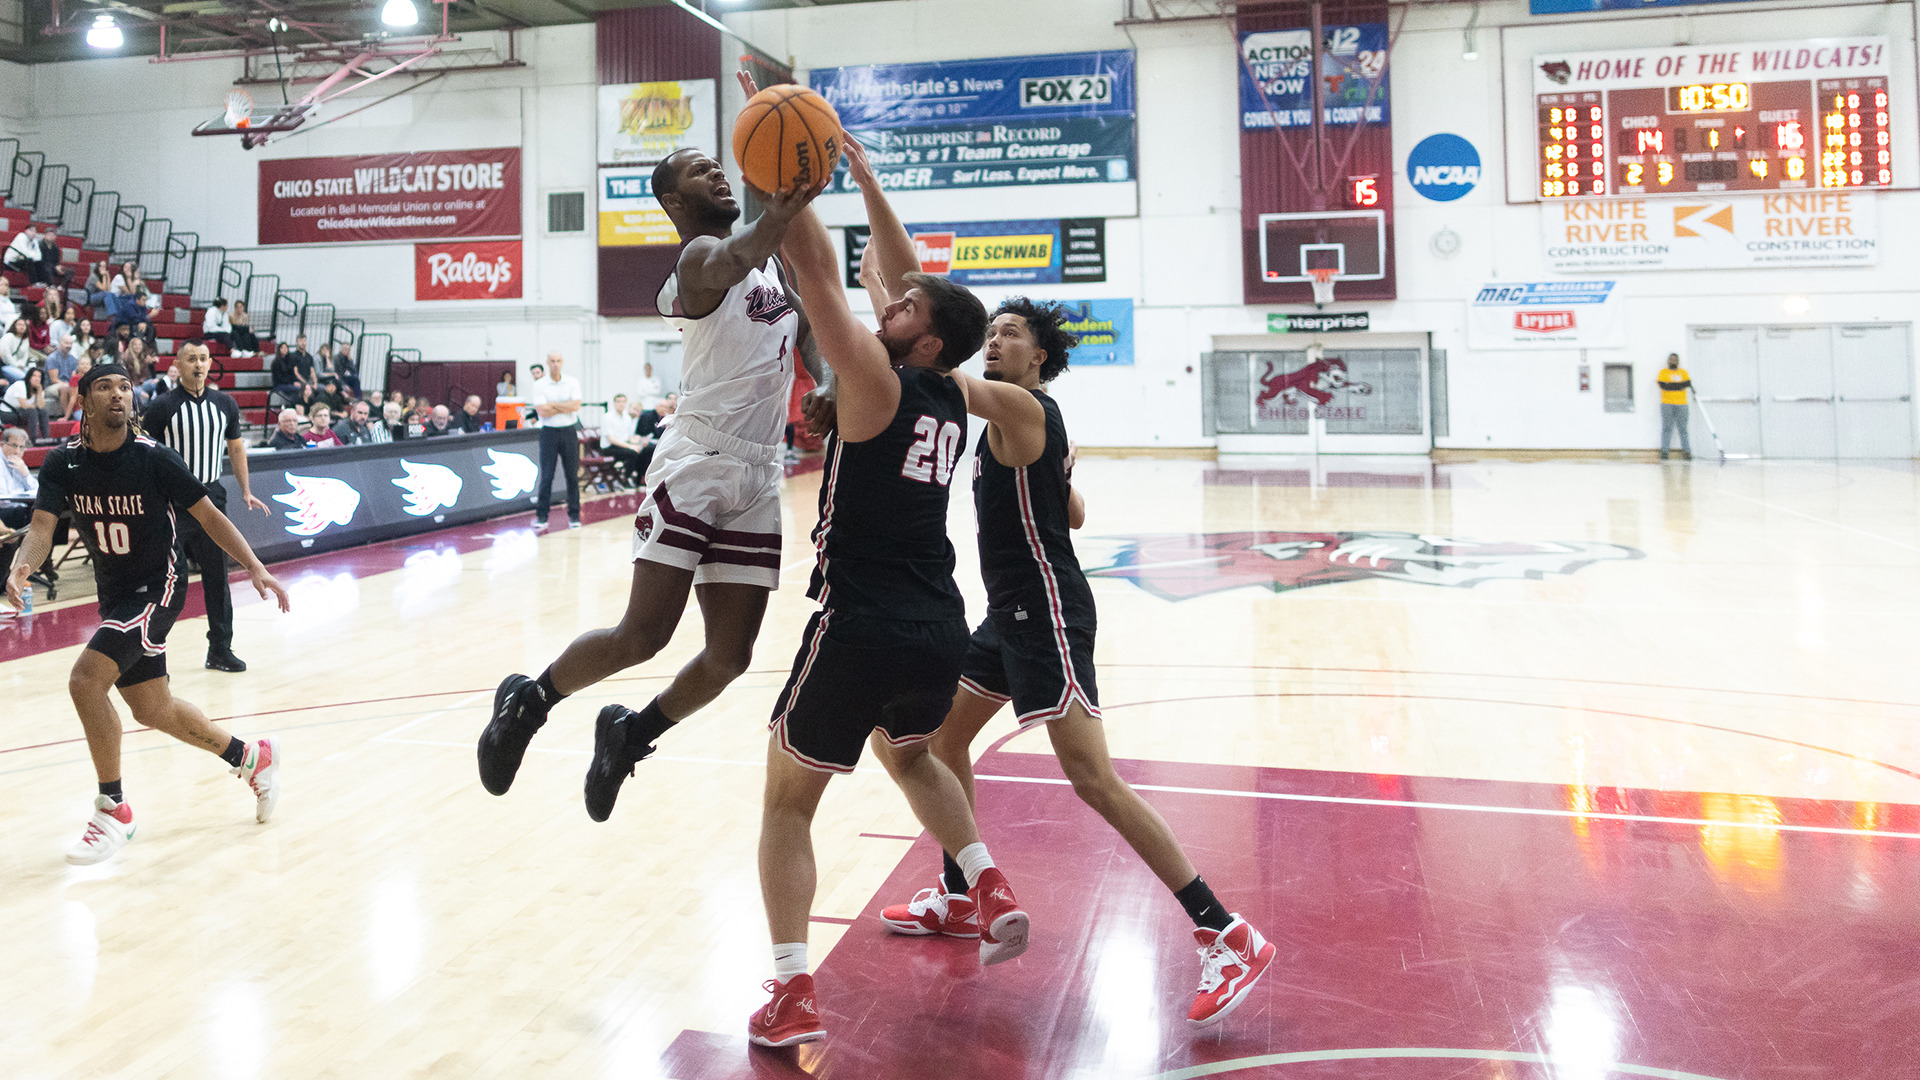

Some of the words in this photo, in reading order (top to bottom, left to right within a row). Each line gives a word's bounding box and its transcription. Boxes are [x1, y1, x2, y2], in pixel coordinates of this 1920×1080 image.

[1332, 27, 1361, 50] 12
[1255, 62, 1310, 79] NEWS
[1577, 57, 1645, 80] HOME
[1656, 56, 1686, 77] OF
[1699, 52, 1739, 74] THE
[1752, 44, 1884, 72] WILDCATS!
[963, 78, 1004, 92] News
[1025, 80, 1072, 103] FOX
[1078, 78, 1107, 101] 20
[1679, 83, 1749, 111] 10:50
[1622, 114, 1658, 128] CHICO
[1759, 108, 1800, 122] GUEST
[993, 123, 1062, 143] RECORD
[1637, 128, 1664, 155] 14
[1776, 120, 1804, 150] 16
[927, 147, 950, 161] #1
[956, 146, 1003, 161] Team
[1006, 143, 1092, 159] Coverage
[274, 180, 312, 199] CHICO
[314, 178, 353, 197] STATE
[354, 164, 437, 195] WILDCAT
[437, 162, 505, 191] STORE
[842, 168, 932, 191] CicoER
[953, 170, 981, 183] Surf
[982, 169, 1014, 182] Less.
[1017, 166, 1061, 182] Expect
[1062, 165, 1099, 178] More.
[1413, 165, 1478, 185] NCAA
[1626, 162, 1643, 186] 2
[1657, 161, 1674, 185] 3
[610, 179, 640, 194] THE
[1355, 179, 1378, 206] 15
[290, 205, 325, 217] Located
[328, 204, 336, 215] in
[339, 203, 356, 215] Bell
[358, 201, 400, 214] Memorial
[403, 200, 429, 212] Union
[432, 202, 442, 211] or
[444, 200, 473, 211] online
[475, 200, 485, 209] at
[1564, 201, 1647, 221] KNIFE
[1764, 193, 1852, 214] KNIFE
[317, 215, 456, 229] ChicoStateWildcatStore.com
[1766, 216, 1854, 237] RIVER
[1566, 223, 1649, 243] RIVER
[957, 245, 980, 261] LES
[984, 244, 1048, 260] SCHWAB
[1548, 244, 1670, 257] CONSTRUCTION
[1747, 239, 1876, 252] CONSTRUCTION
[427, 252, 512, 292] Raley's
[1475, 287, 1524, 302] MAC
[1272, 314, 1368, 332] enterprise
[1258, 407, 1309, 421] CHICO
[1315, 406, 1366, 420] STATE
[902, 414, 961, 486] 20
[74, 494, 103, 515] STAN
[108, 495, 144, 515] STATE
[94, 521, 130, 555] 10
